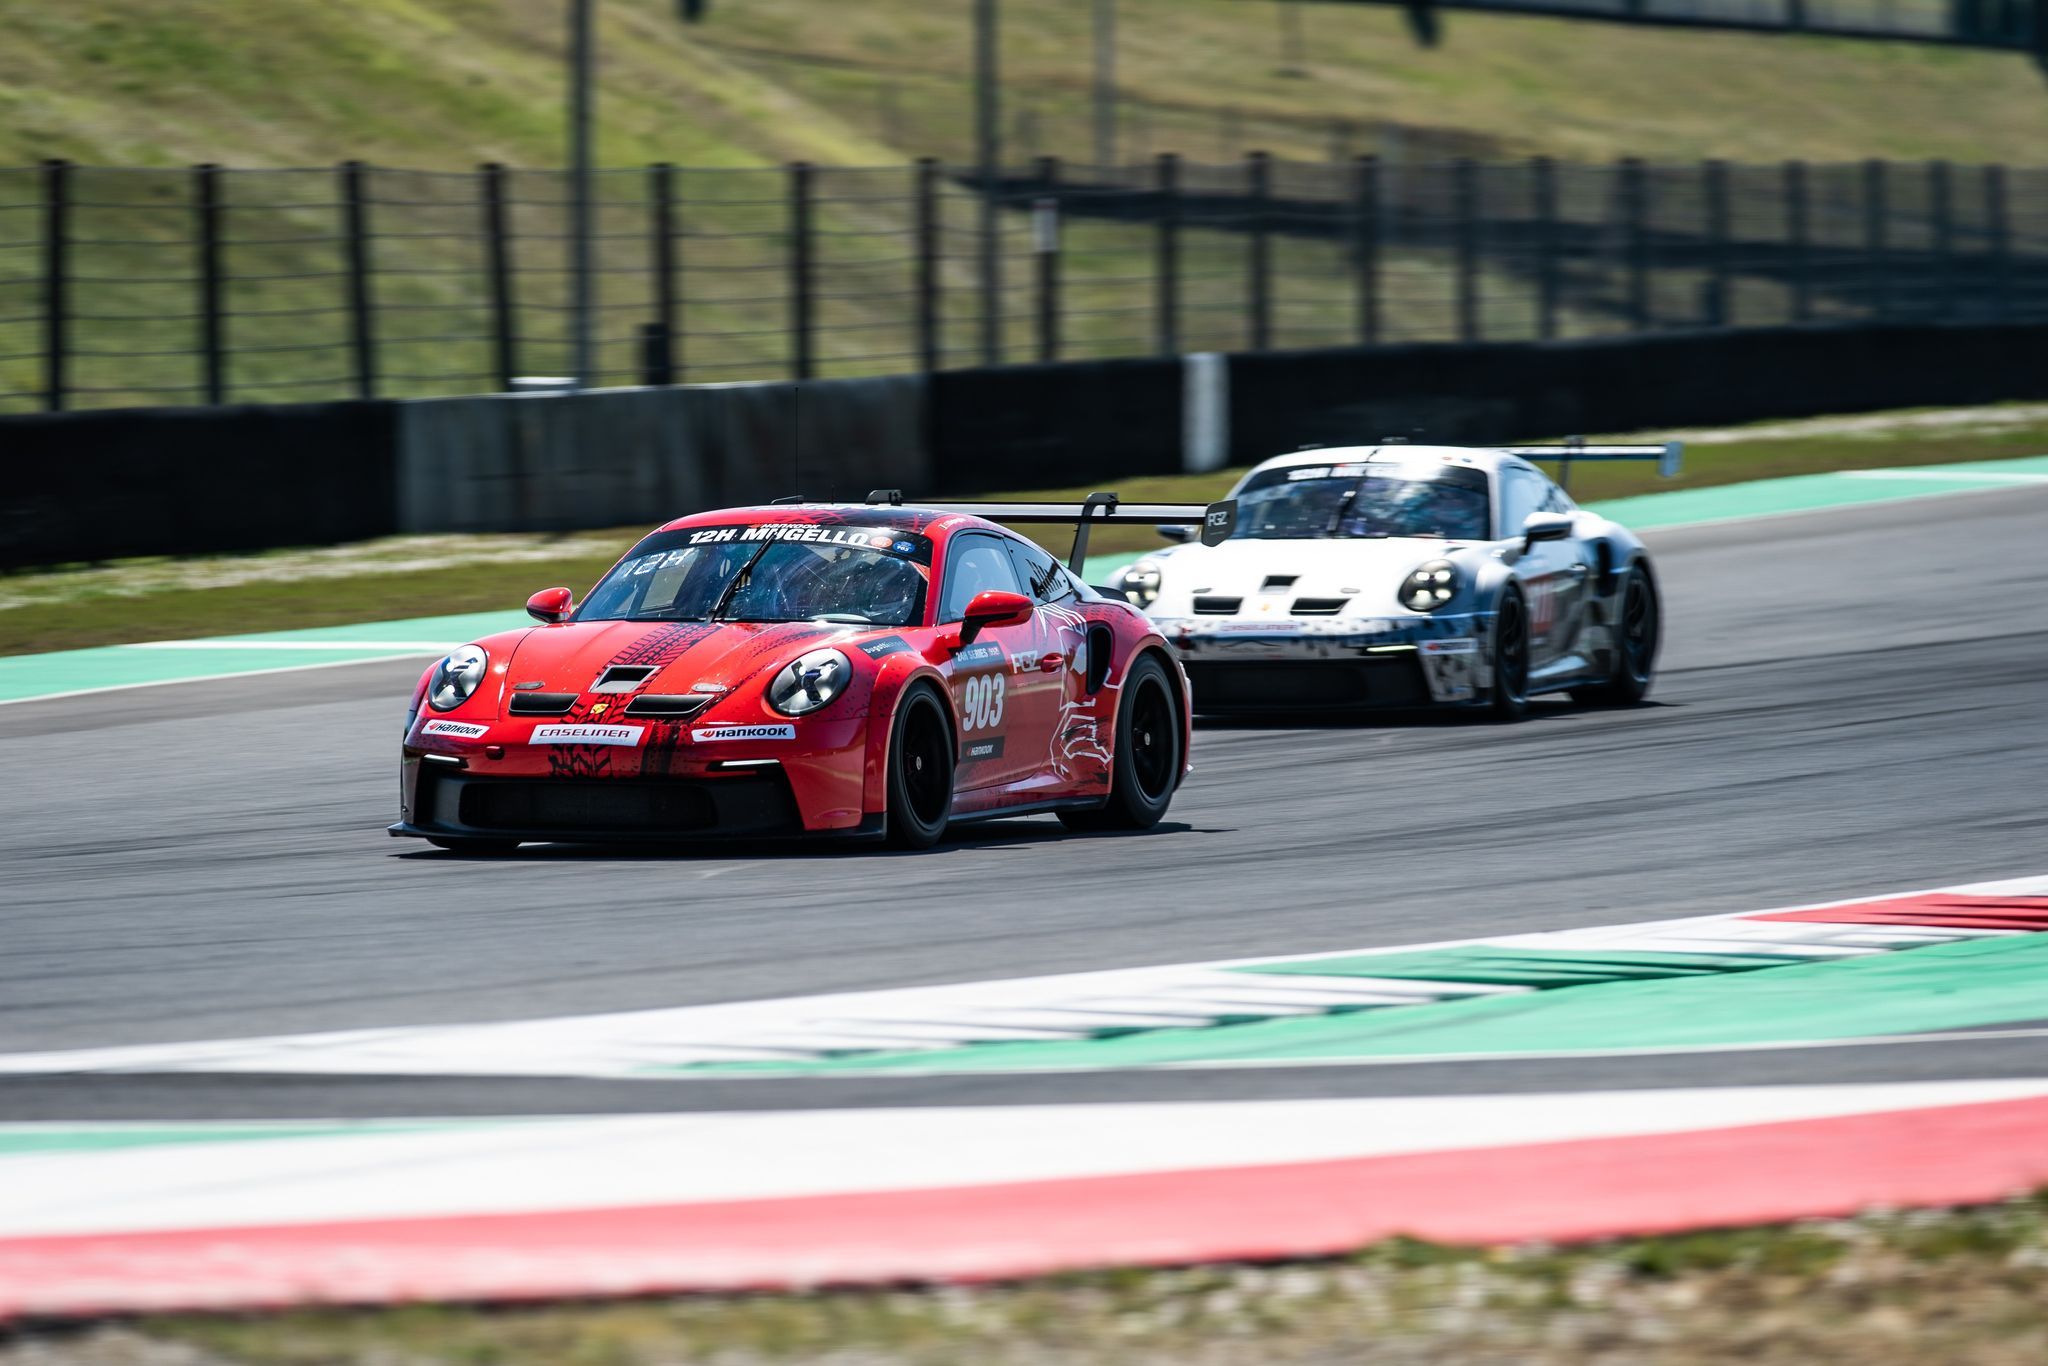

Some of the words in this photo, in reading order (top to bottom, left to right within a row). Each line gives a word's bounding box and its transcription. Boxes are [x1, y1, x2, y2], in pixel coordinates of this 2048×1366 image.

[689, 529, 738, 544] 12H
[740, 527, 869, 545] MUGELLO
[968, 647, 989, 660] SERIES
[963, 672, 1005, 732] 903
[539, 728, 630, 738] CASELINER
